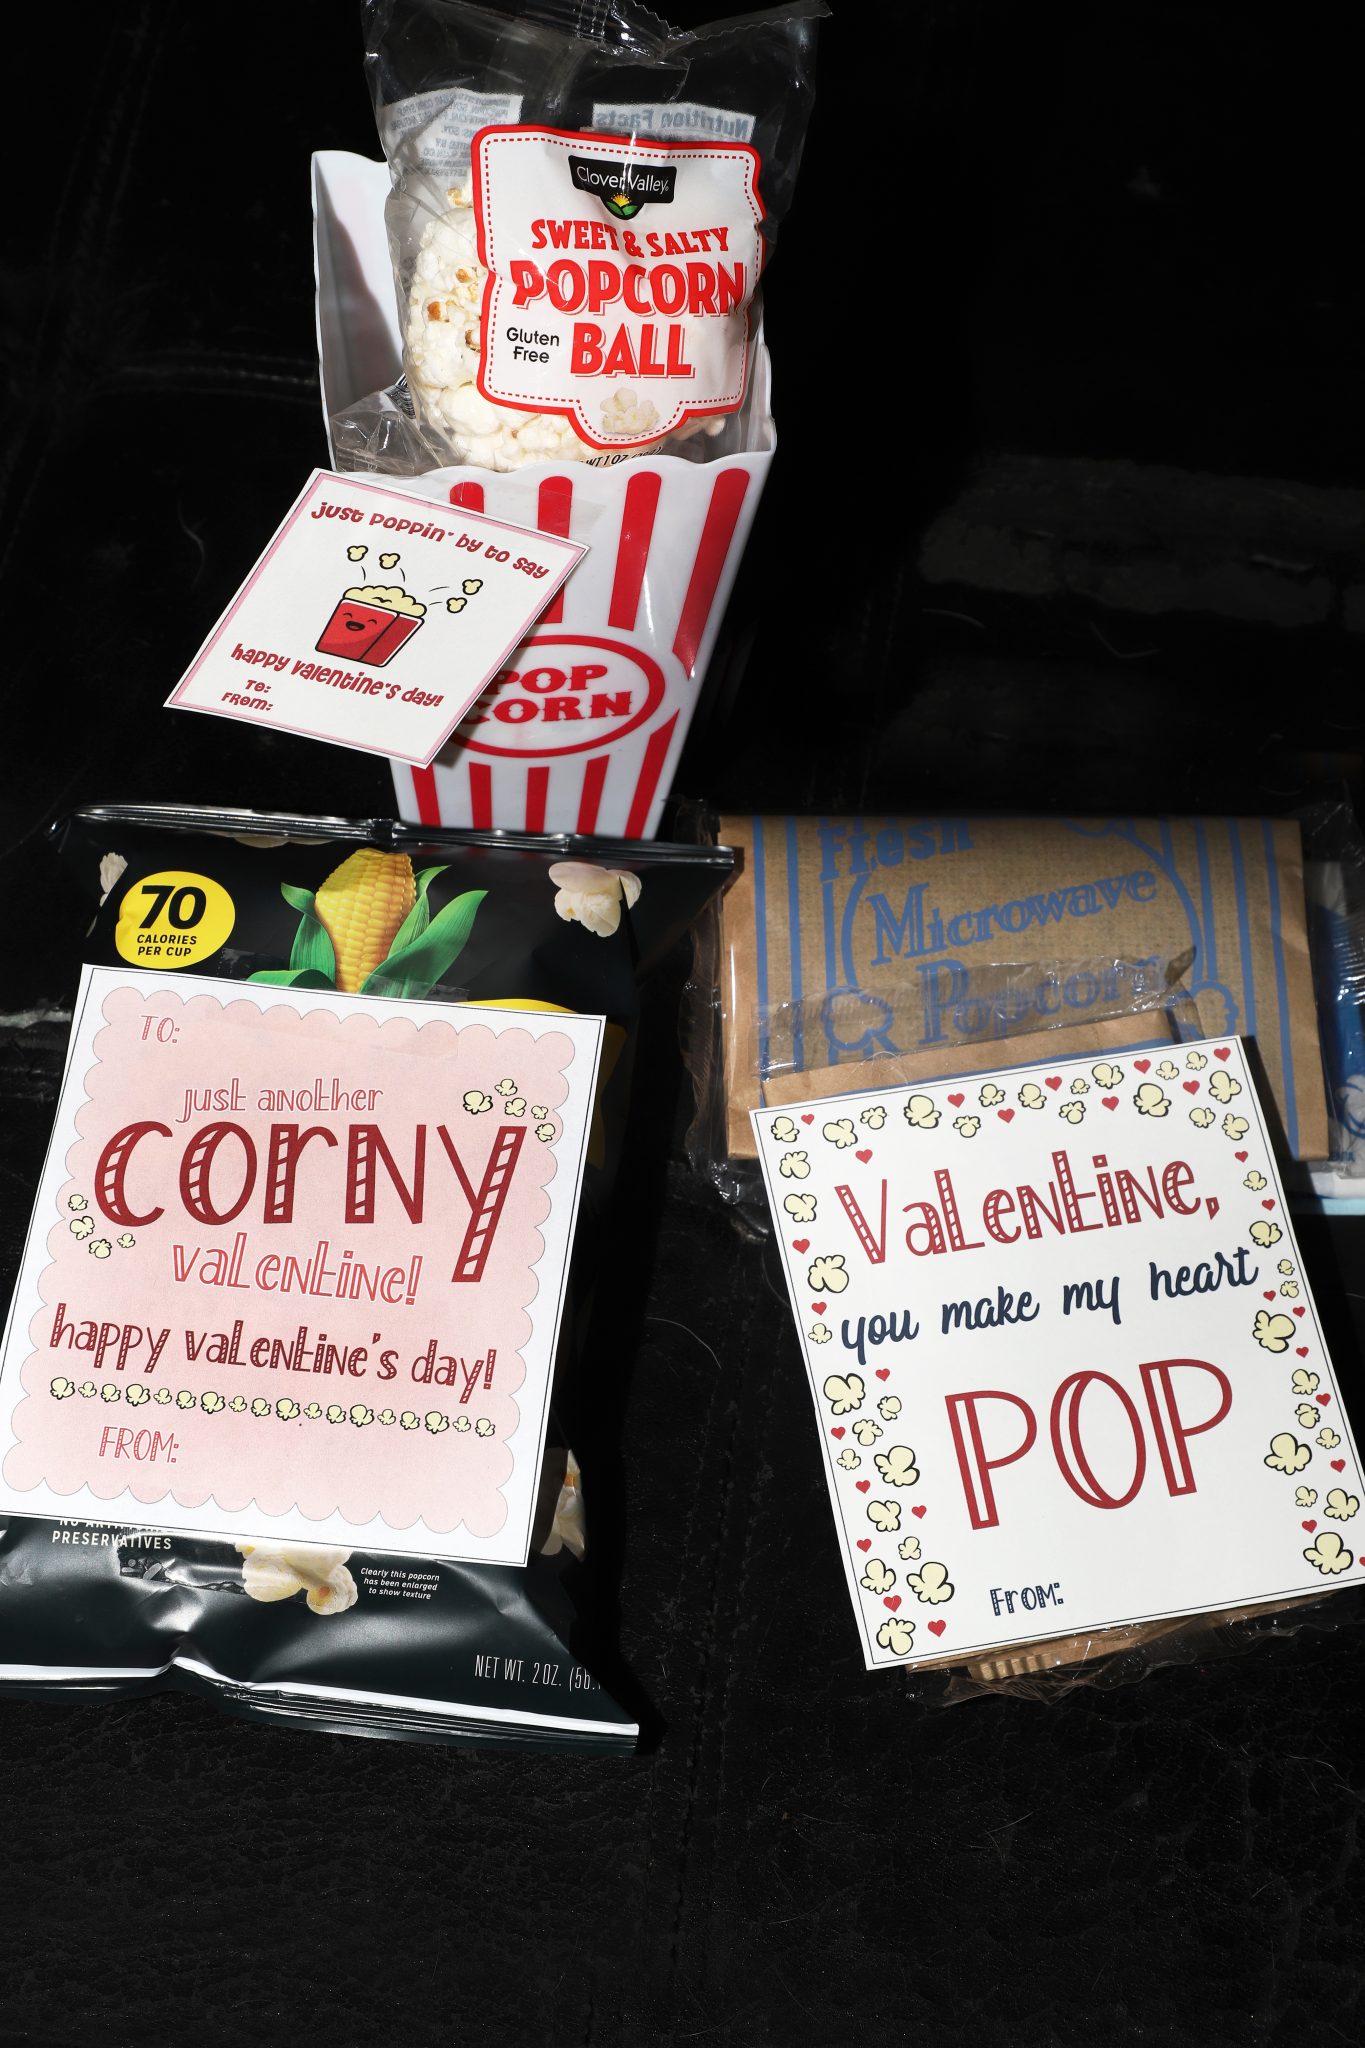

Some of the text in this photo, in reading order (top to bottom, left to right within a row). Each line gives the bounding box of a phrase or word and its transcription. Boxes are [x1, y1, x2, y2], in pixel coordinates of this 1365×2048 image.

[577, 166, 668, 194] Clover Valley
[531, 219, 728, 258] SWEET & SALTY
[510, 259, 747, 318] POPCORN
[507, 327, 559, 346] Gluten
[570, 322, 695, 378] BALL
[514, 346, 549, 363] Free
[312, 502, 547, 578] just poppin' by to say
[232, 644, 442, 705] happy valentine's day!
[487, 664, 608, 695] POP
[139, 885, 206, 929] 70
[865, 870, 1158, 967] Microwave
[137, 935, 196, 944] CALORIES
[138, 947, 191, 956] PER CUP
[140, 1015, 180, 1045] TO:
[176, 1078, 382, 1123] just another
[842, 1247, 1258, 1365] you make my heart
[50, 1303, 170, 1373] happy
[411, 1340, 497, 1404] day!
[99, 1427, 180, 1463] FROM:
[946, 1360, 1231, 1528] POP
[52, 1530, 172, 1550] PRESERVATIVES
[360, 1567, 440, 1582] Clearly this popcorn
[363, 1577, 438, 1592] has been enlarged
[379, 1588, 401, 1596] show
[402, 1590, 432, 1600] texture
[474, 1654, 500, 1679] NET
[504, 1658, 526, 1683] WT.
[532, 1662, 540, 1684] 2
[542, 1663, 562, 1687] OZ.
